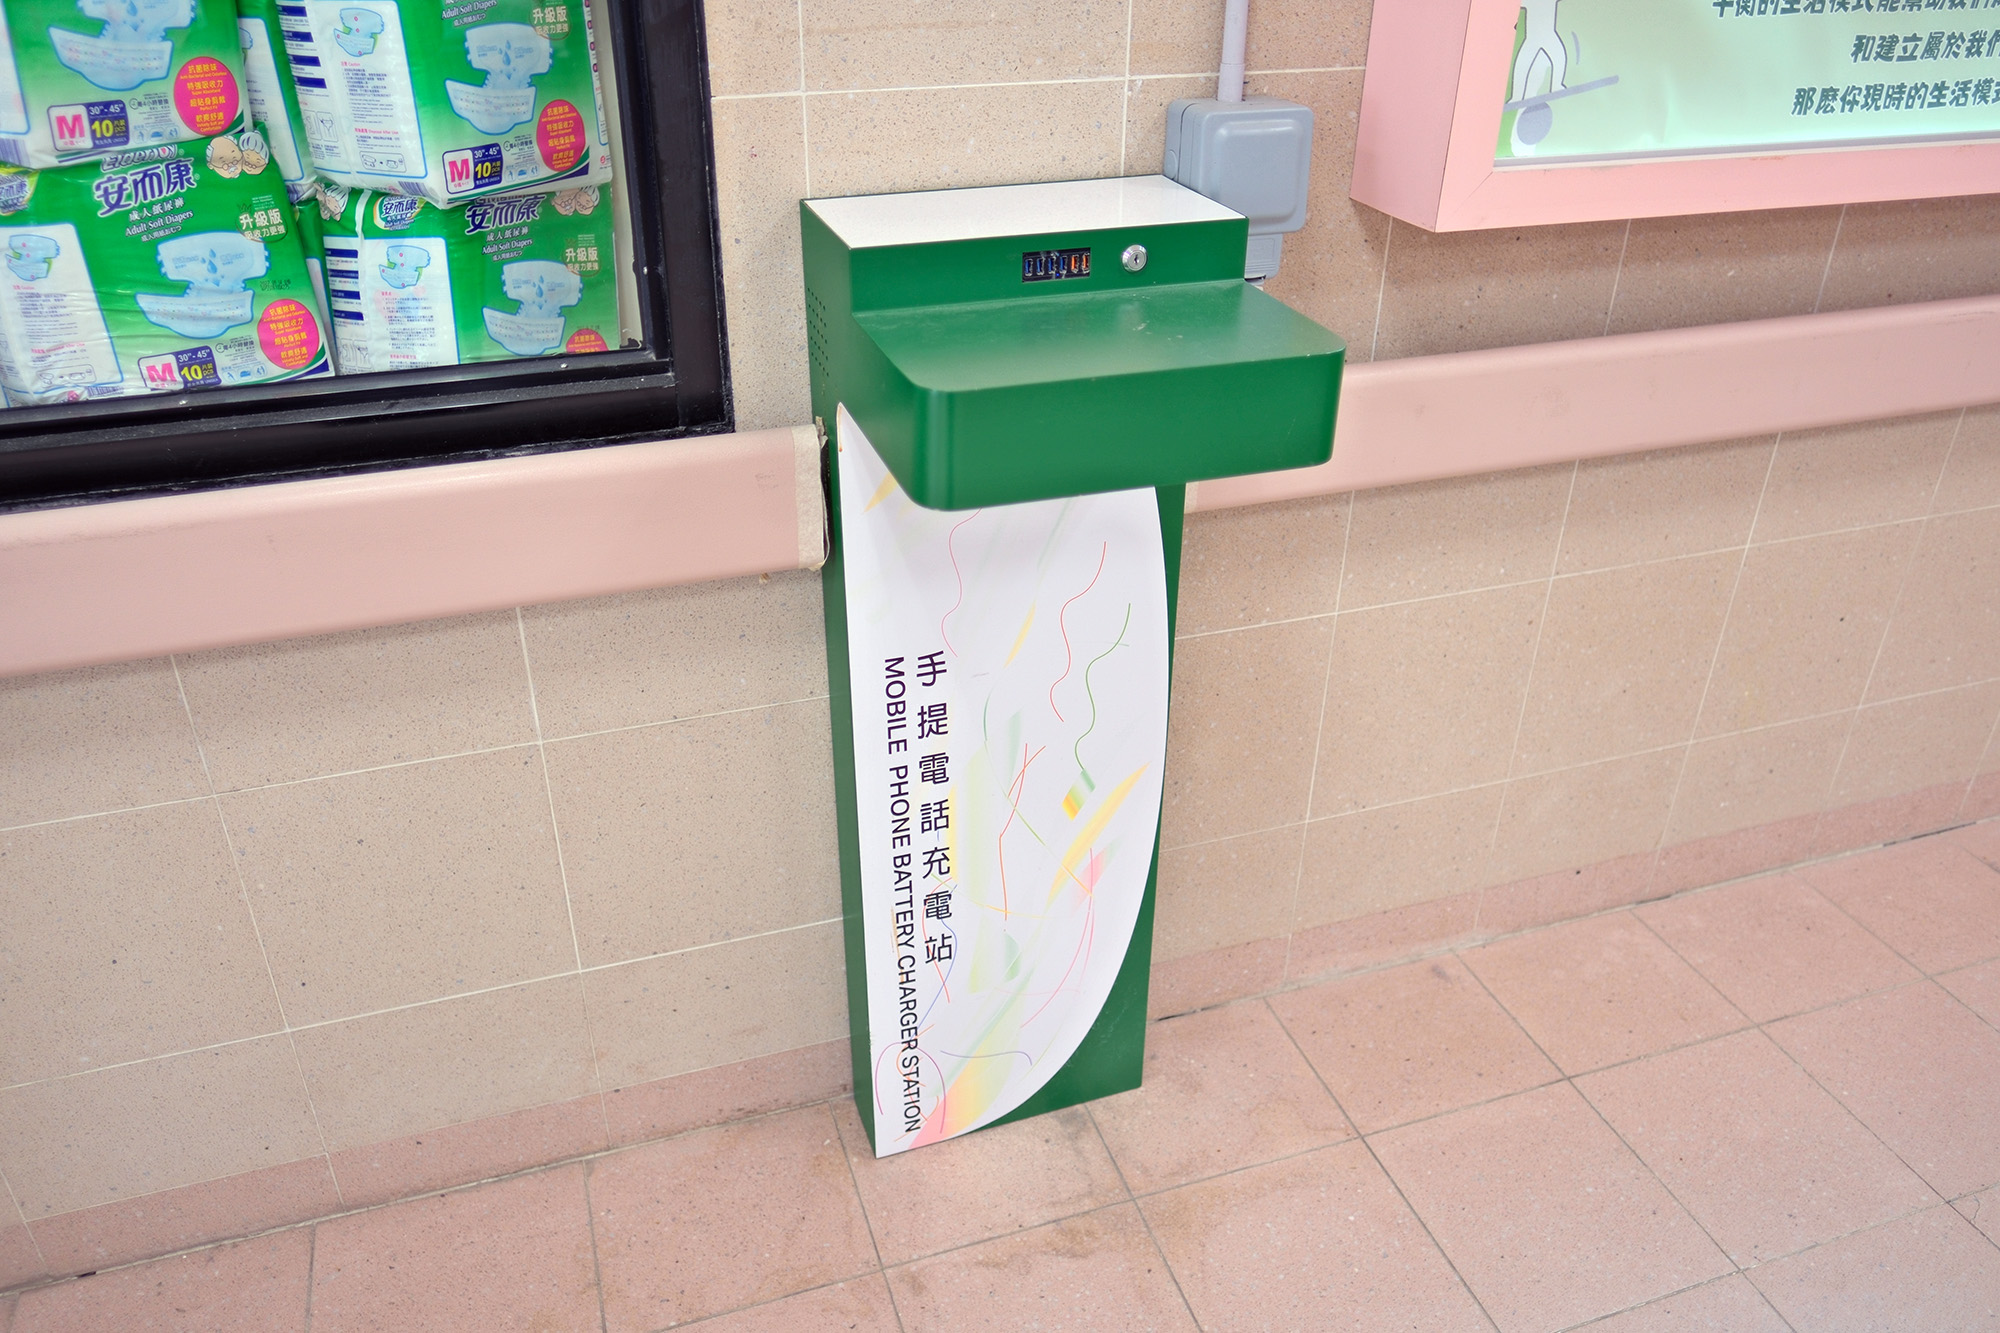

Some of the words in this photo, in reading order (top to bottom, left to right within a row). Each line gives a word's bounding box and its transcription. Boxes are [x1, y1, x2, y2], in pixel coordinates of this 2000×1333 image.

[532, 6, 568, 24] 升級版
[55, 113, 86, 140] M
[91, 119, 114, 138] 10
[448, 158, 470, 183] M
[475, 162, 492, 179] 10
[95, 158, 196, 216] 安而康
[125, 223, 147, 237] Adult
[148, 218, 164, 230] Soft
[165, 211, 194, 225] Diapers
[239, 208, 283, 230] 升級版
[467, 195, 545, 233] 安而康
[482, 242, 498, 254] Adult
[499, 240, 511, 251] Soft
[511, 238, 533, 250] Diapers
[565, 247, 599, 262] 升級版
[145, 362, 177, 383] M
[180, 364, 203, 381] 10
[884, 656, 908, 755] MOBILE
[889, 765, 911, 850] PHONE
[916, 650, 953, 964] 手提電話充電站
[893, 853, 915, 949] BATTERY
[897, 955, 919, 1052] CHARGER
[901, 1055, 921, 1133] STATION
